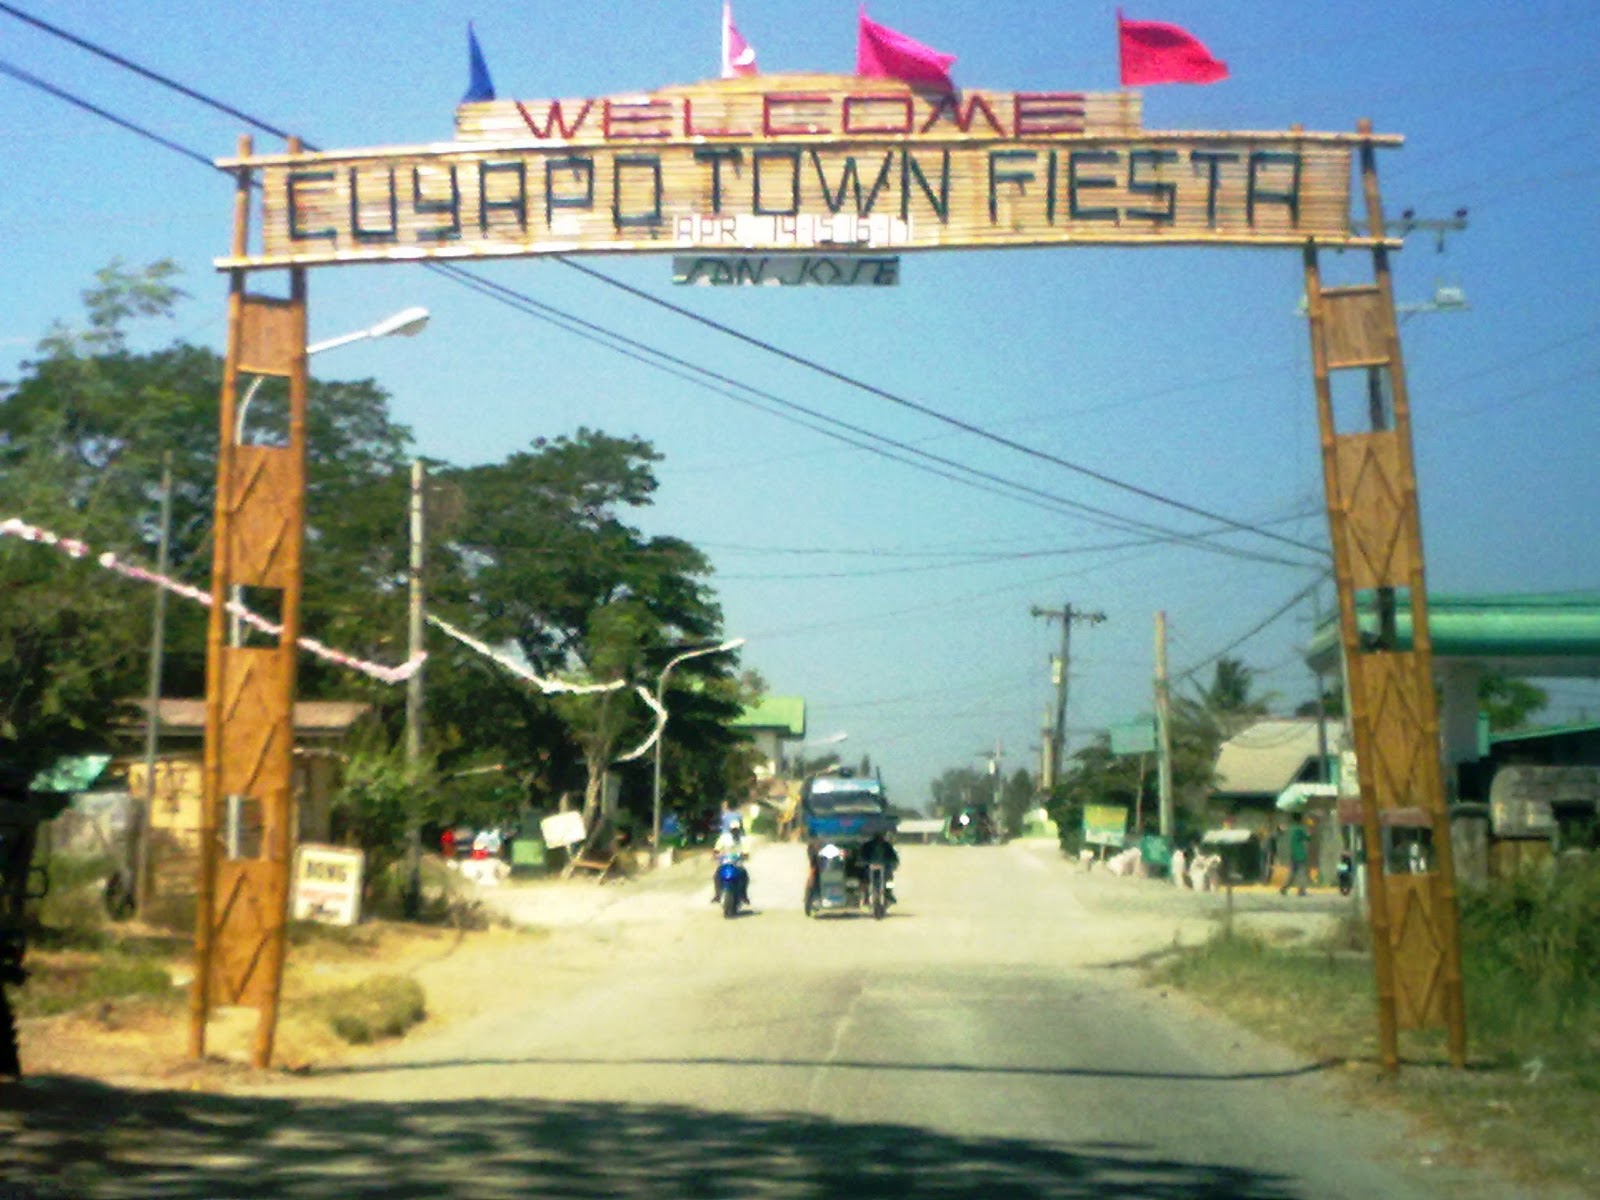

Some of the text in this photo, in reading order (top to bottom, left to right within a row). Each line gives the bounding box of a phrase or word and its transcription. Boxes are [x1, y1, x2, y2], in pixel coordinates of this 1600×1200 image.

[515, 91, 1085, 141] WELCOME
[286, 147, 1303, 241] CUYAPO TOWN FIESTA
[677, 214, 738, 241] APR
[778, 256, 900, 285] JOSE
